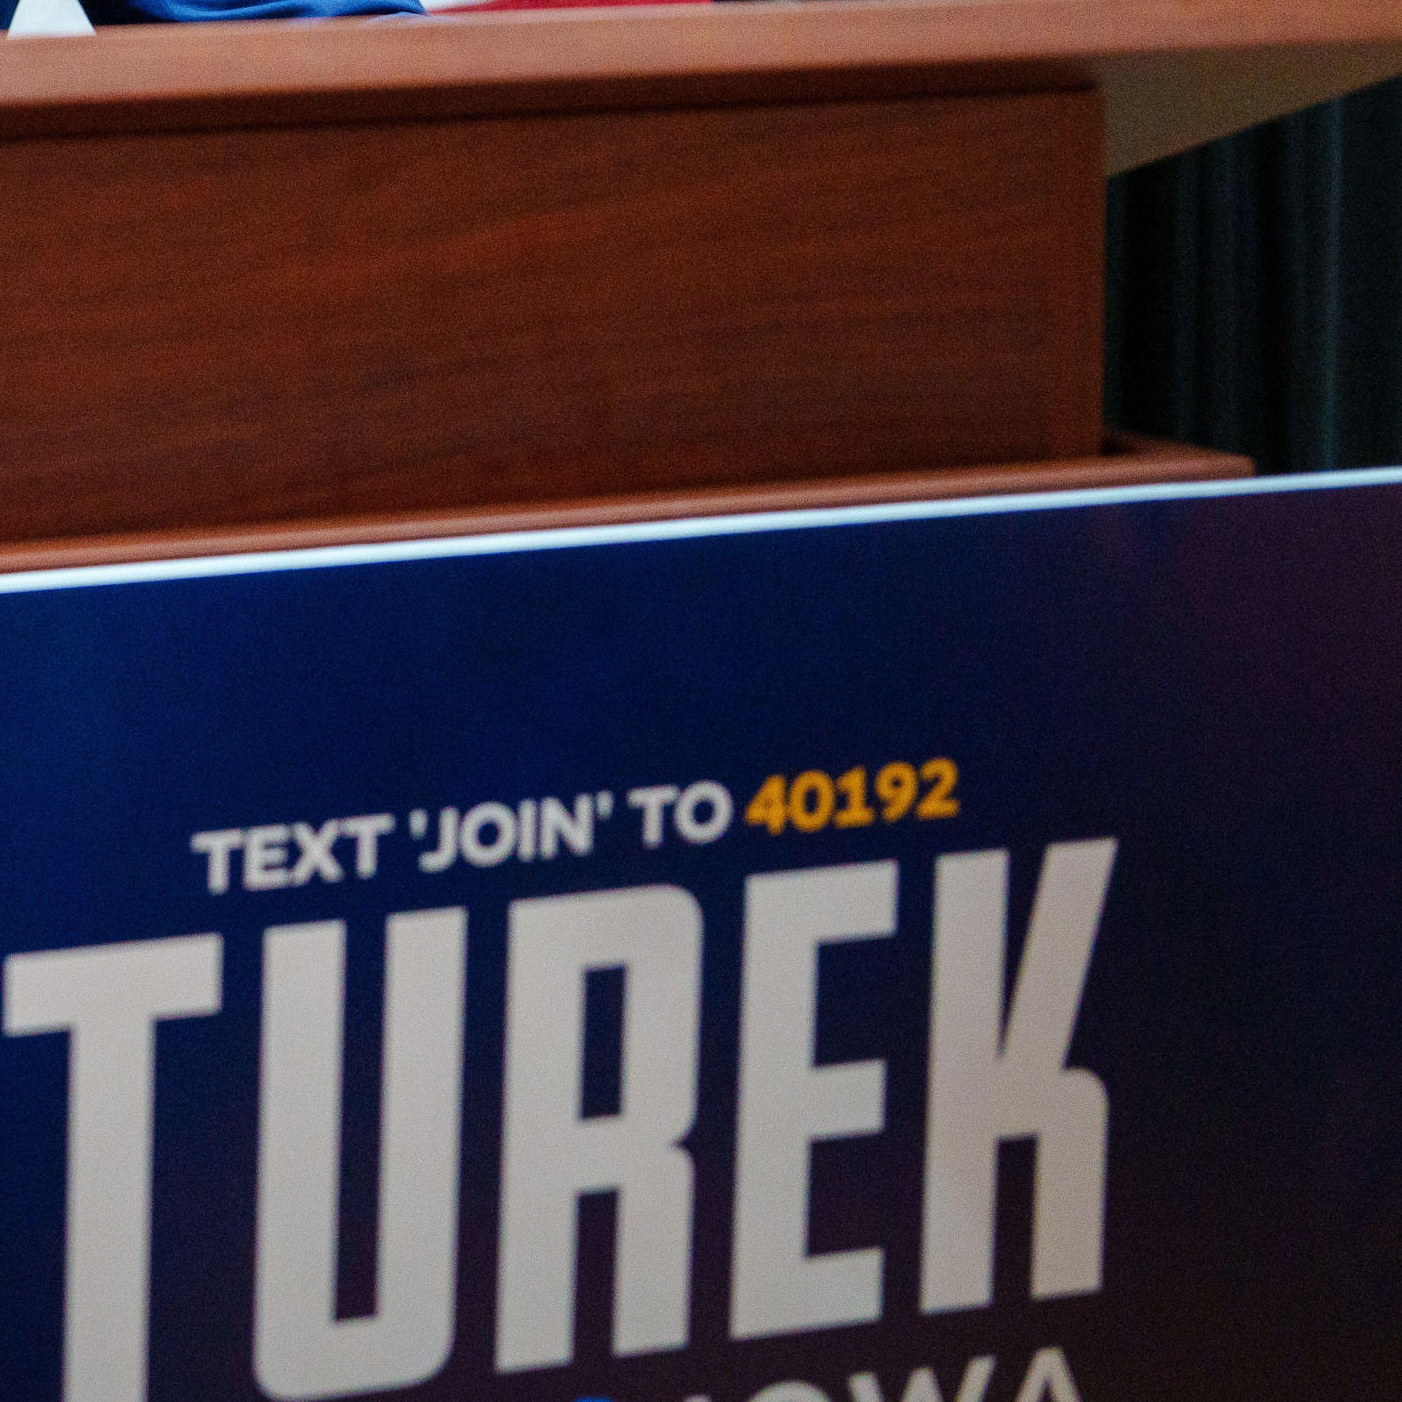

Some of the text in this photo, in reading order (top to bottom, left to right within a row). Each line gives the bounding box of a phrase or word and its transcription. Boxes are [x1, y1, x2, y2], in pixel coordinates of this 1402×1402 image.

[190, 757, 960, 895] TEXT 'JOIN' TO 40192
[2, 837, 1117, 1402] TUREK
